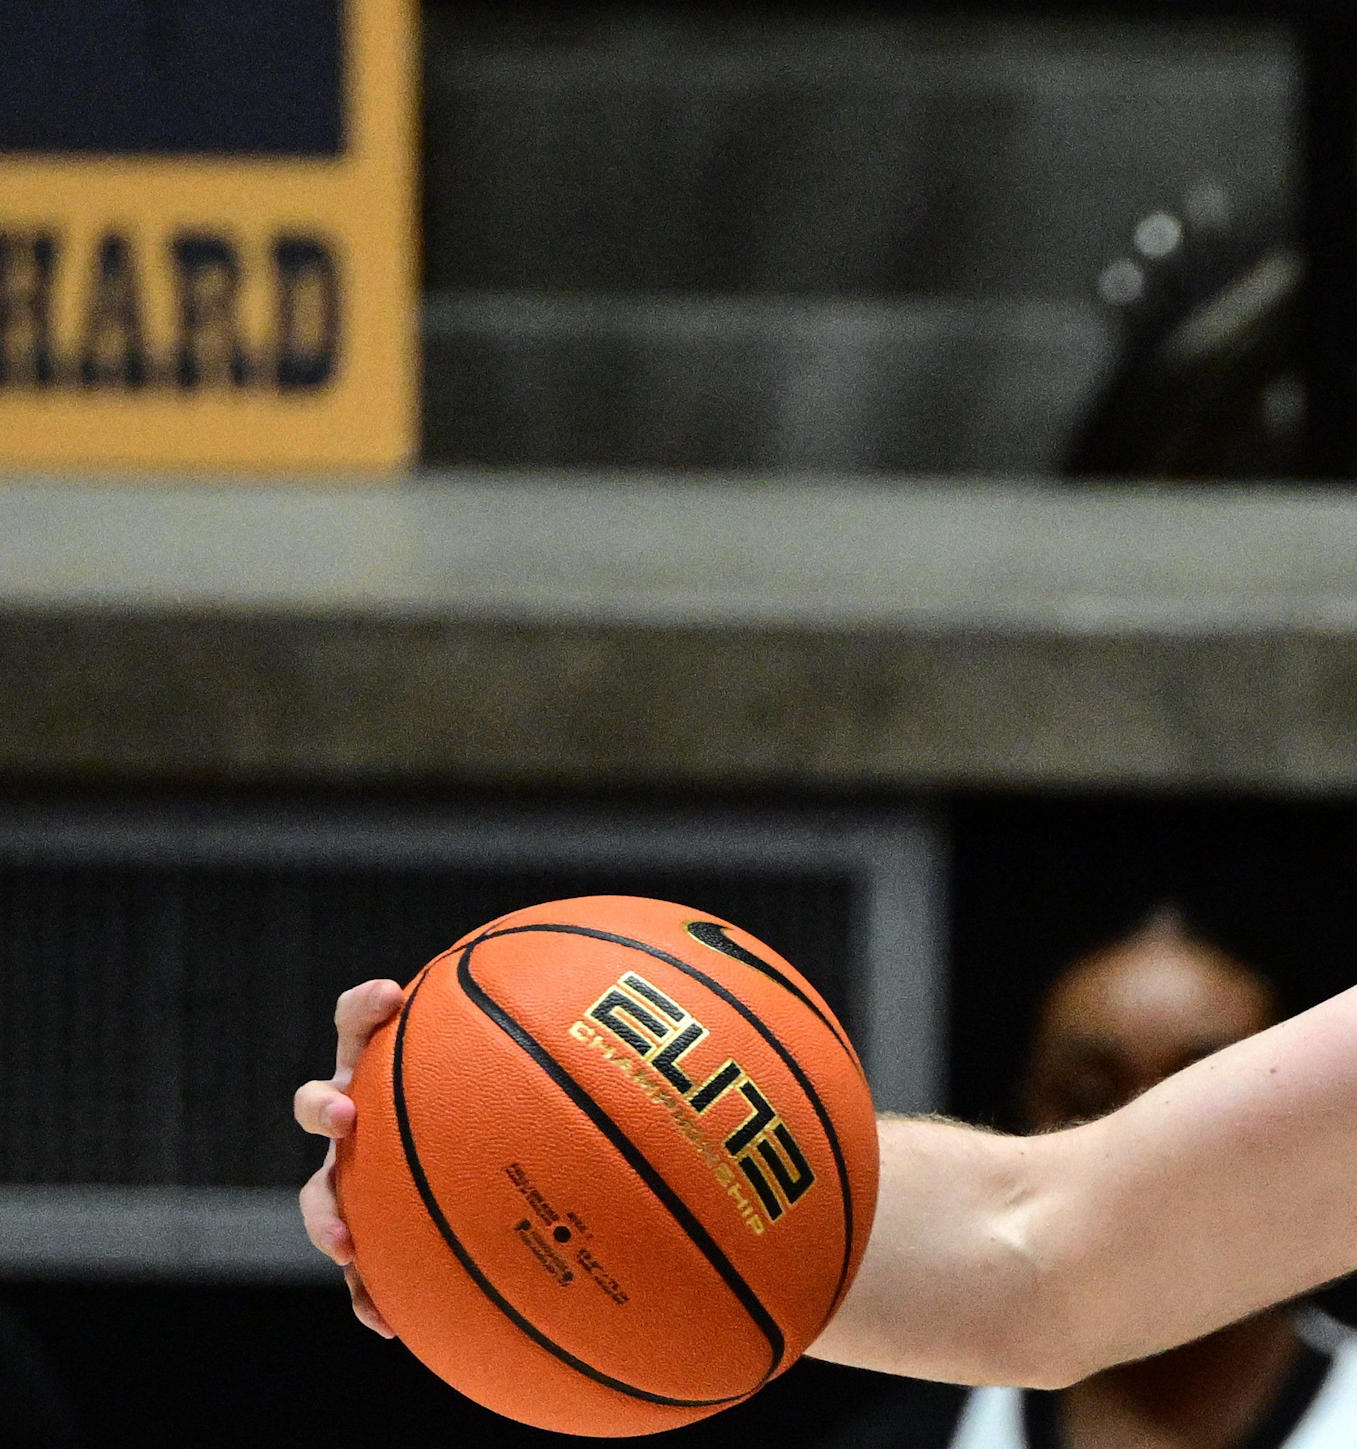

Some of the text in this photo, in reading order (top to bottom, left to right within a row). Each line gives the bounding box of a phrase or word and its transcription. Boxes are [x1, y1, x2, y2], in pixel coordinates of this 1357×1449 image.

[0, 225, 344, 392] HARD
[568, 1020, 766, 1236] CHAMPIONSHIP
[584, 971, 816, 1224] ELITE
